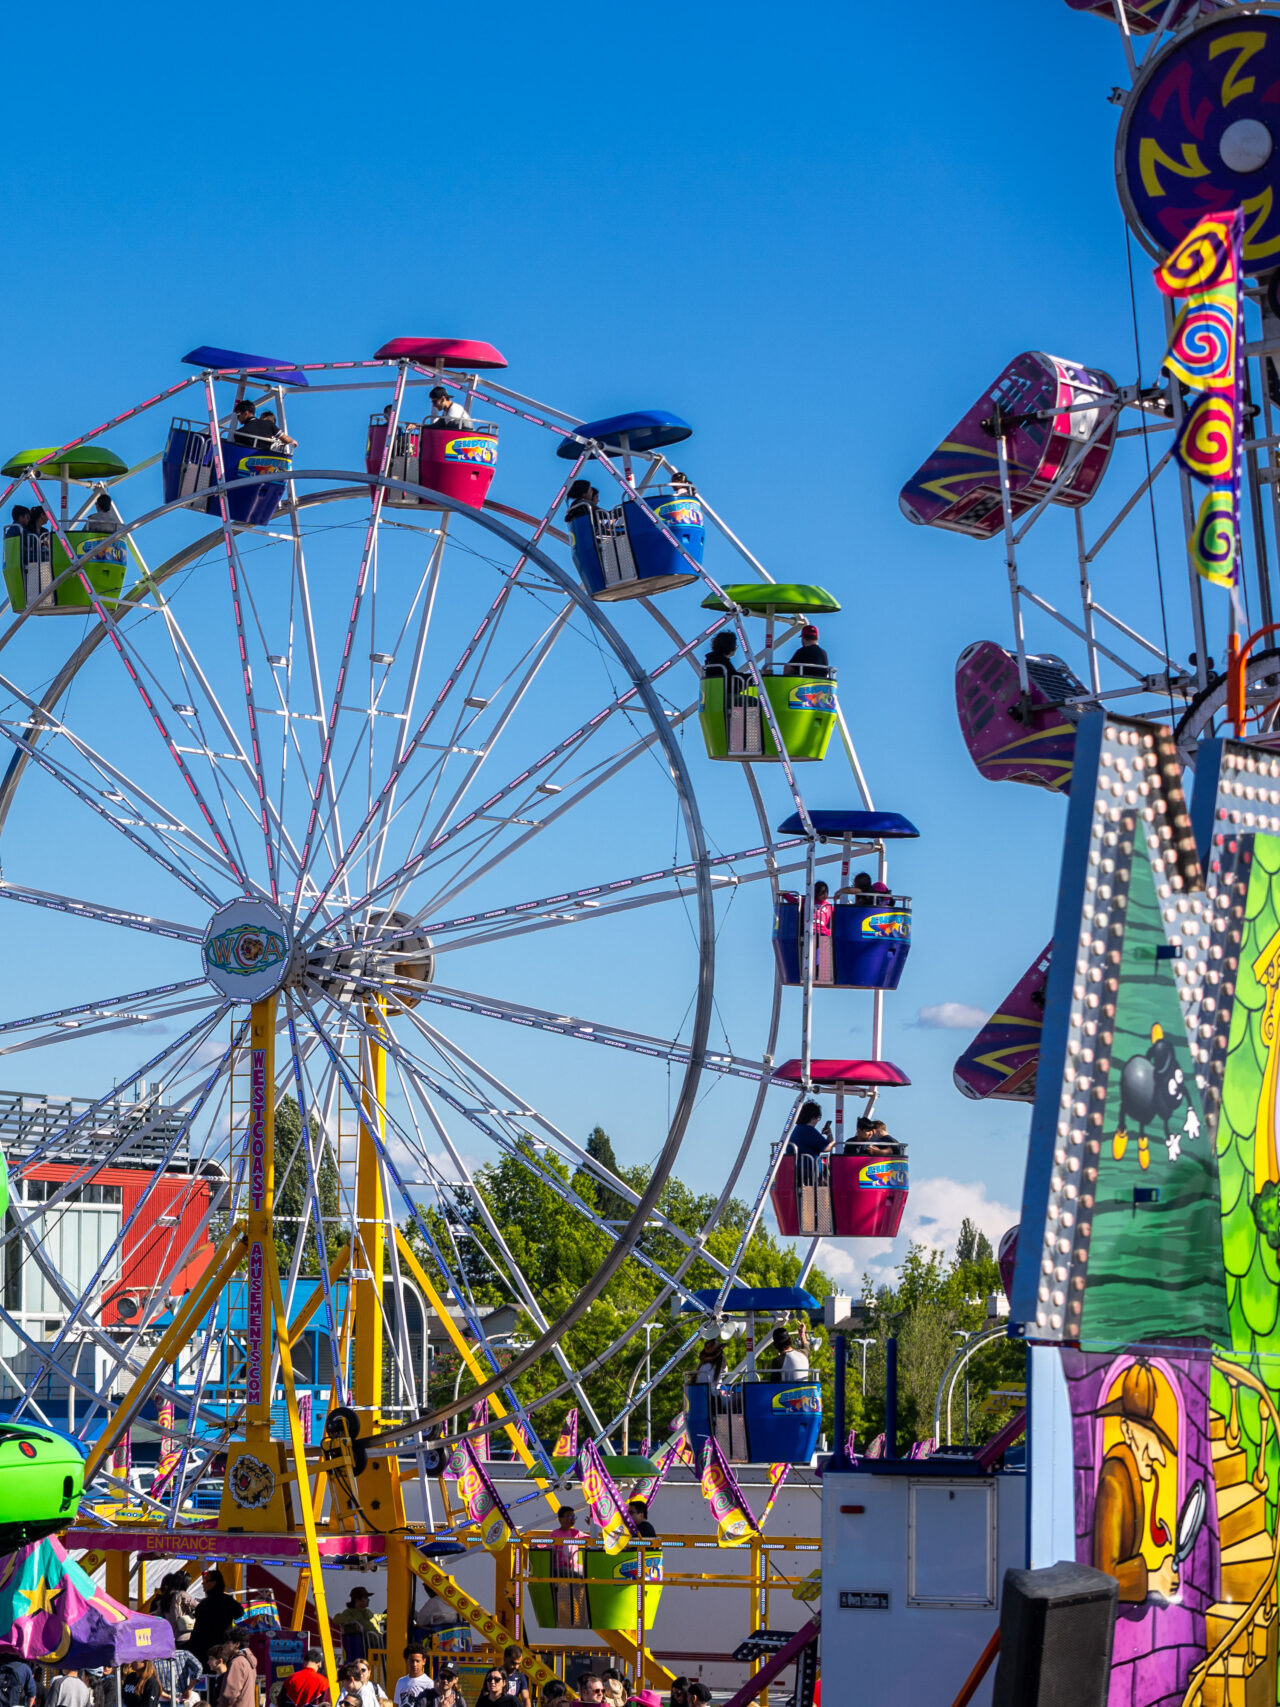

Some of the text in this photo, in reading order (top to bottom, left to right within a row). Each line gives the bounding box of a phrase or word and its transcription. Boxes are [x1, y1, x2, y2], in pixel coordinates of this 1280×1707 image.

[211, 931, 284, 967] WCA
[251, 1049, 266, 1211] WESTCOAST
[146, 1536, 216, 1550] ENTRANCE
